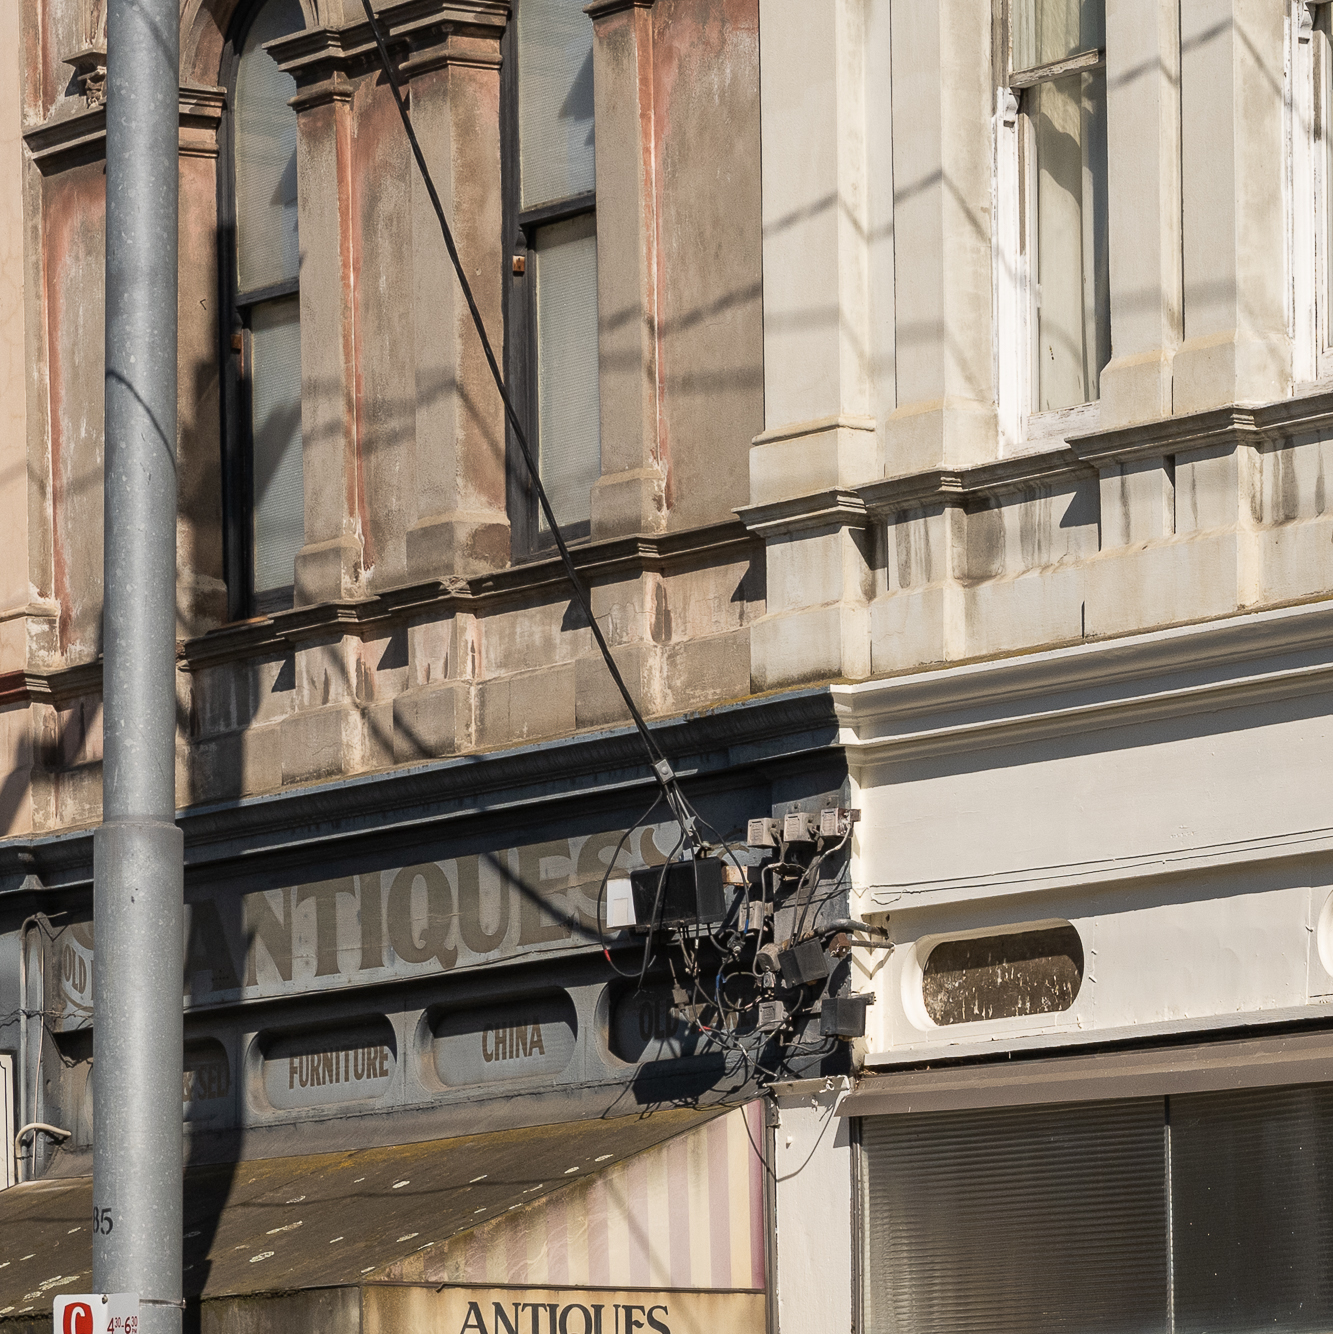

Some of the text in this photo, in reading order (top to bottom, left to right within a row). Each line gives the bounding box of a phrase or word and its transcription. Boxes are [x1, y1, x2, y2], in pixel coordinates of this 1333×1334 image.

[183, 828, 634, 1000] ANTIQUES
[62, 942, 87, 996] OLD
[480, 1013, 546, 1064] CHINA
[638, 998, 680, 1042] OLD
[287, 1040, 390, 1090] FURNITURE
